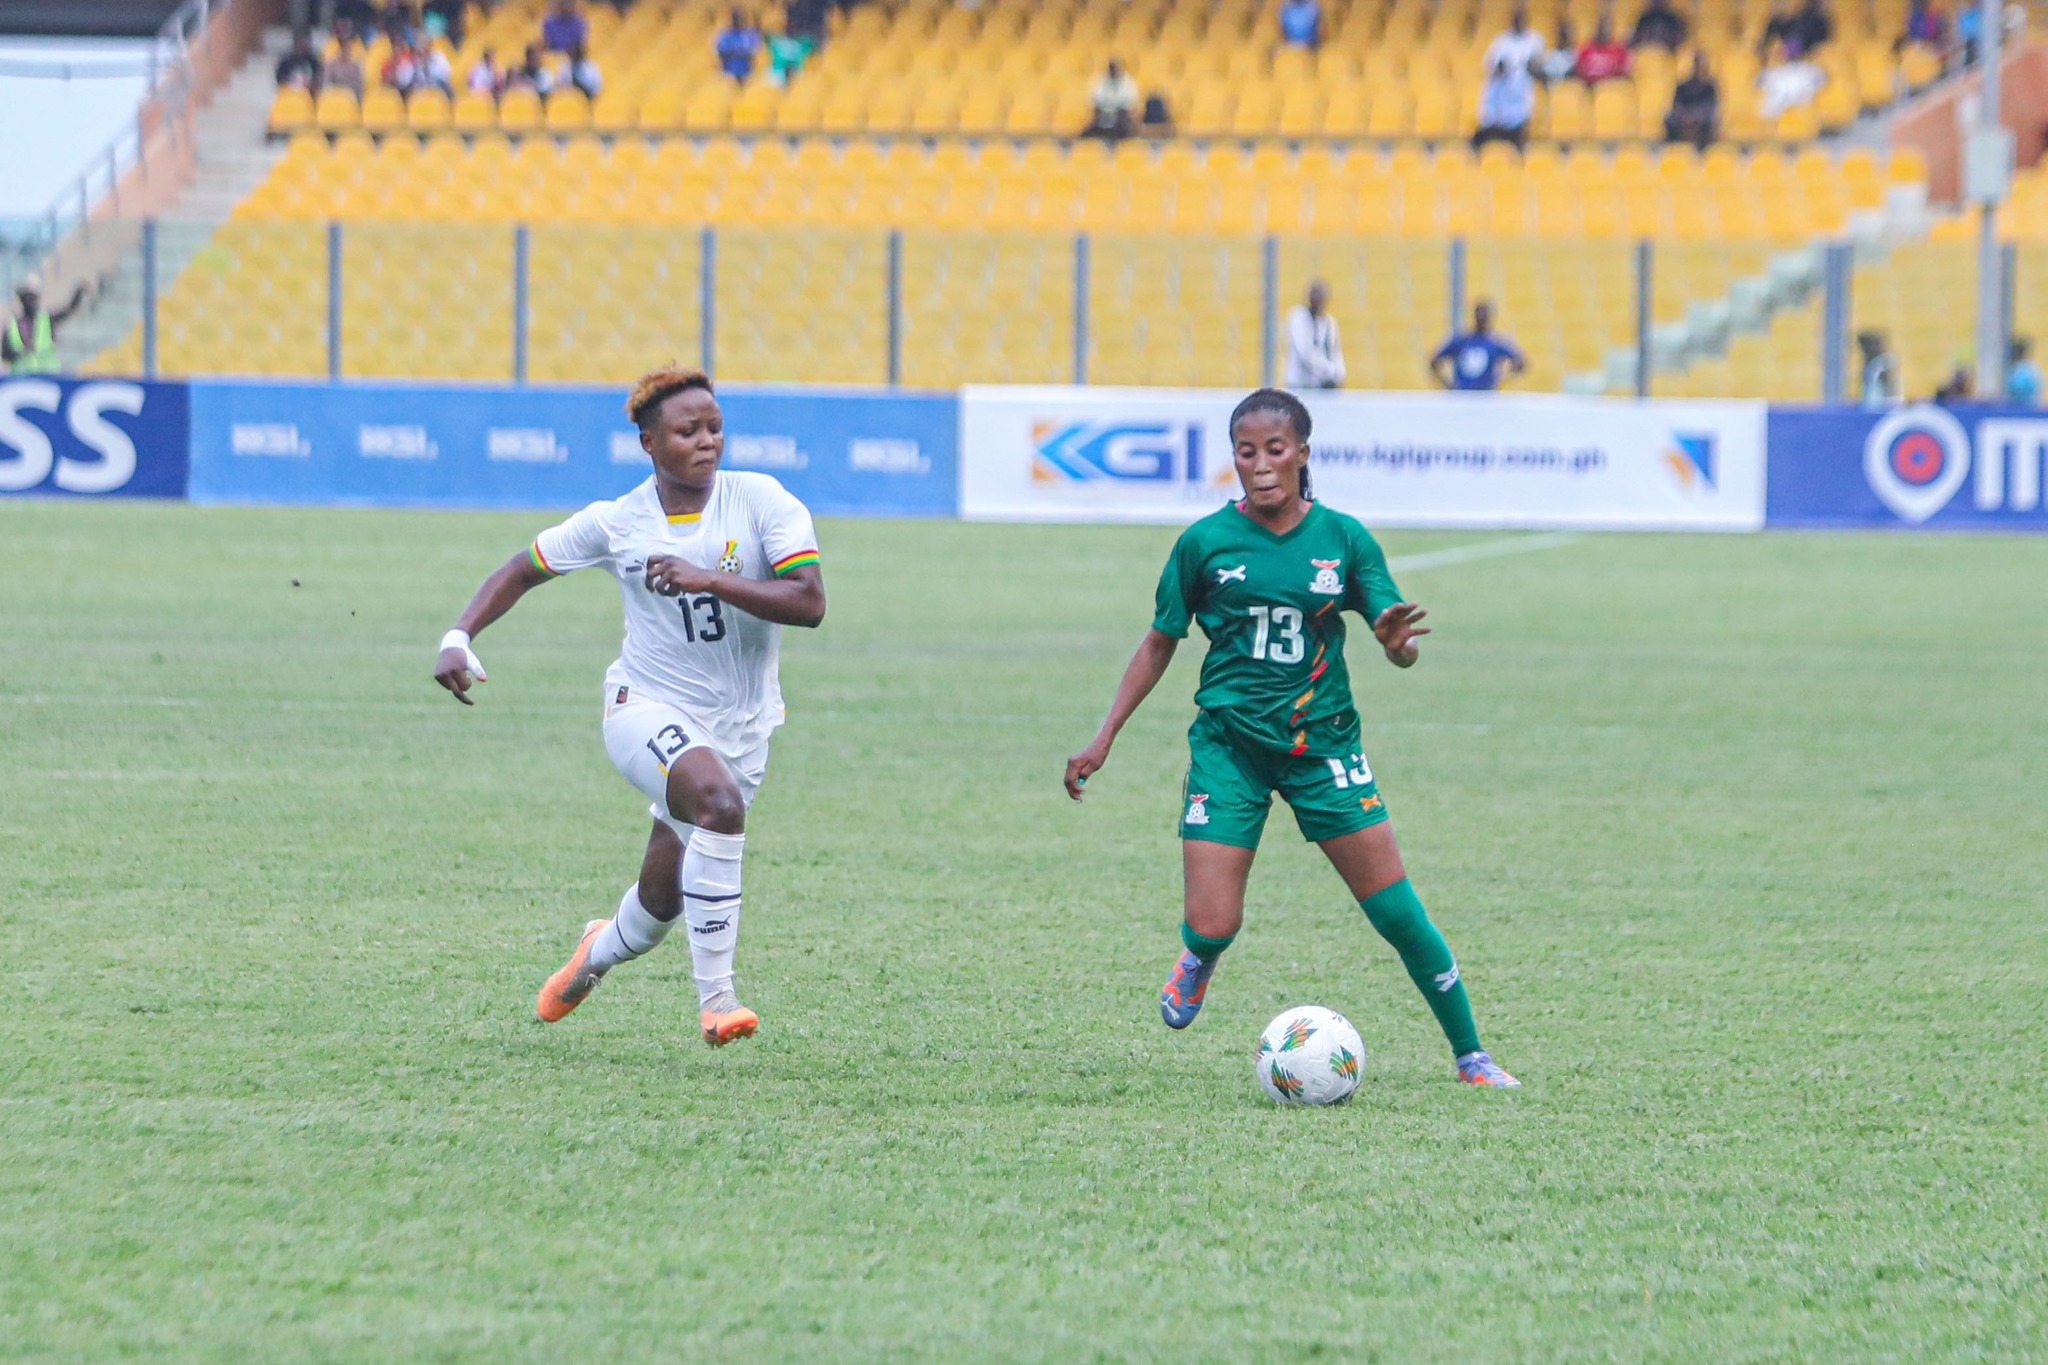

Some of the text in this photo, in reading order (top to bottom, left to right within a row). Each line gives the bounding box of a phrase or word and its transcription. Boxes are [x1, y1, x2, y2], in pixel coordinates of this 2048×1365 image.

[678, 596, 727, 643] 13
[1249, 605, 1305, 664] 13
[646, 723, 691, 767] 13
[1326, 752, 1373, 788] 13
